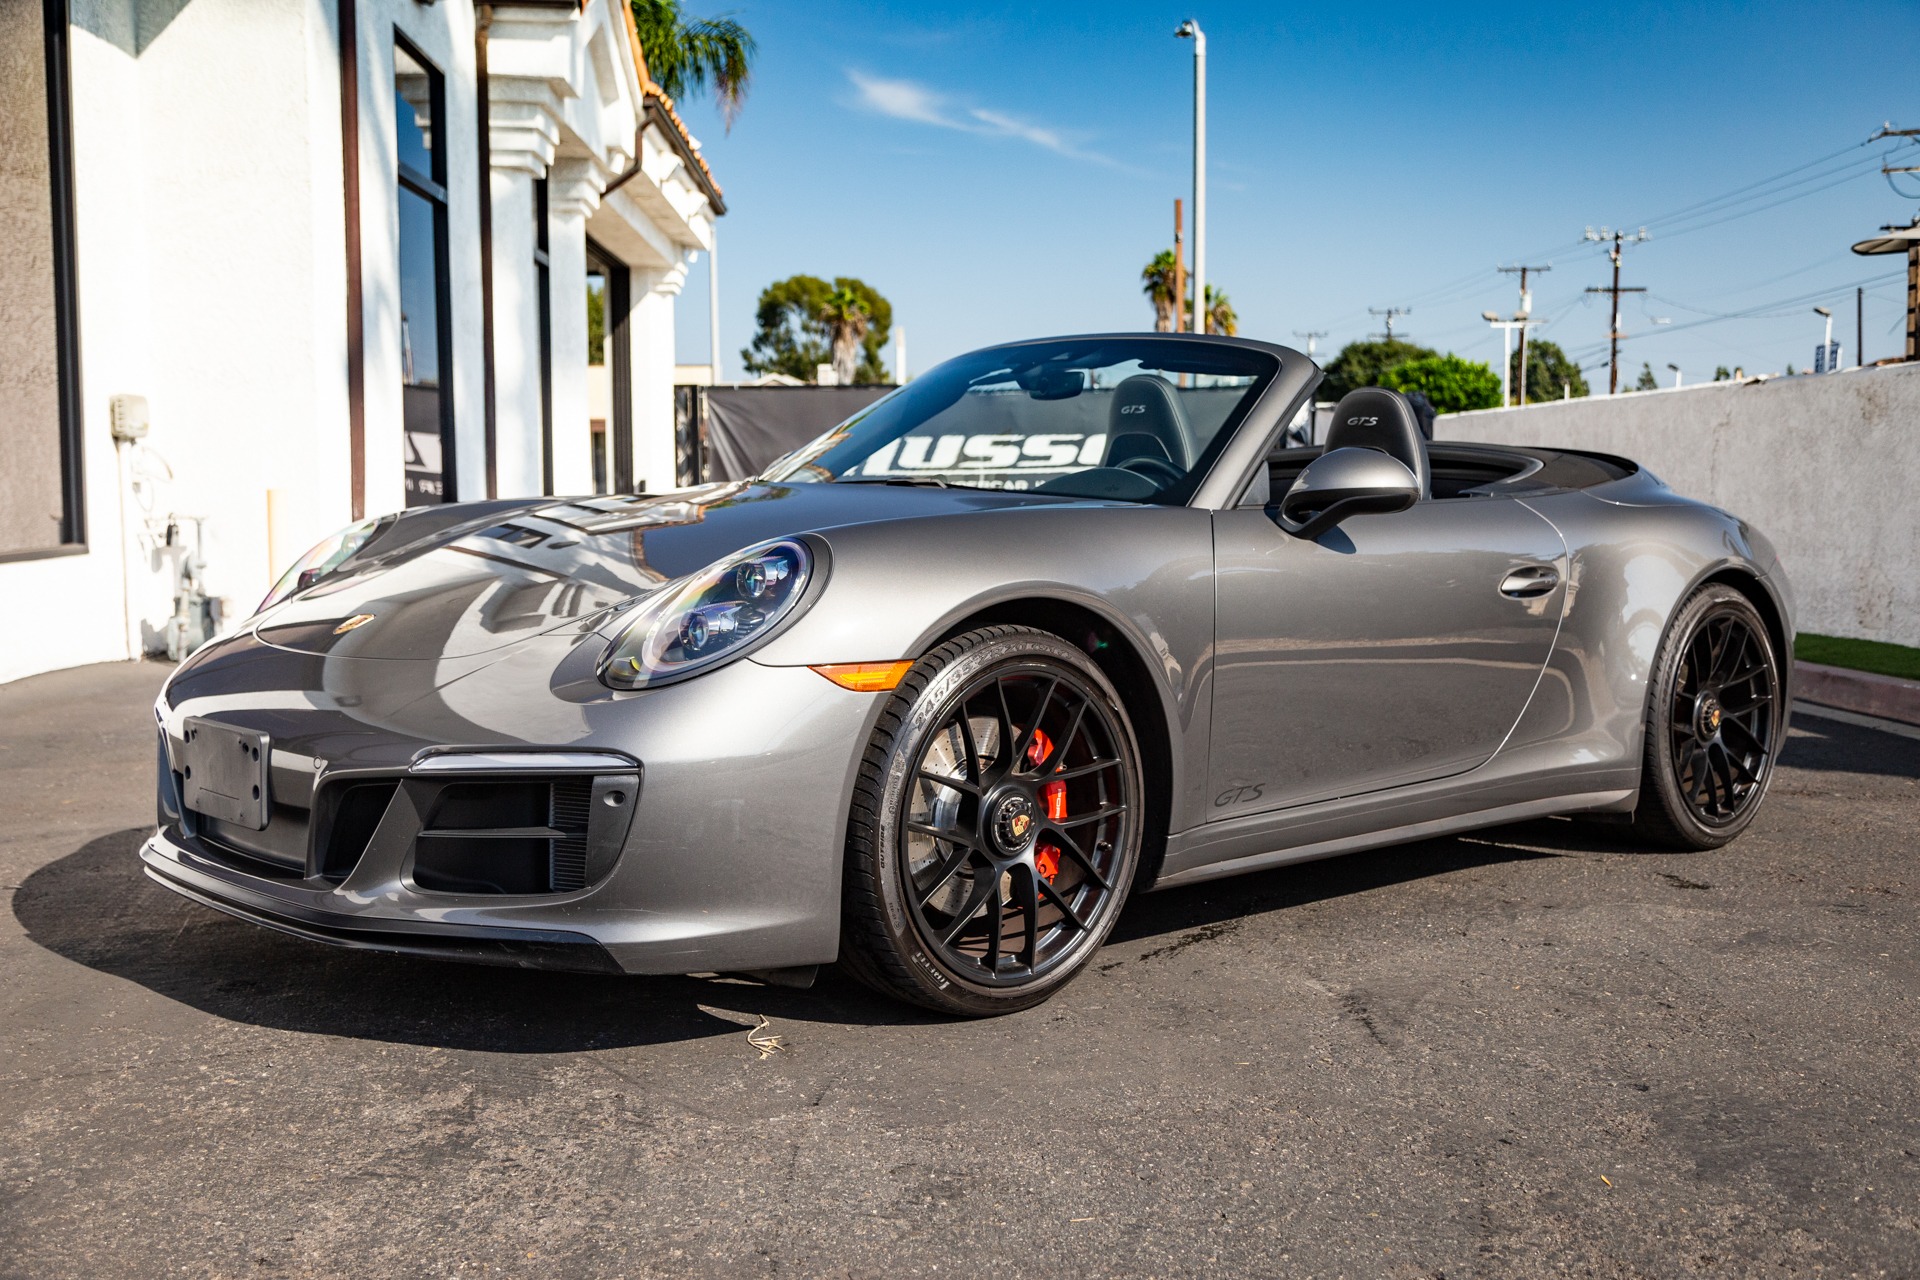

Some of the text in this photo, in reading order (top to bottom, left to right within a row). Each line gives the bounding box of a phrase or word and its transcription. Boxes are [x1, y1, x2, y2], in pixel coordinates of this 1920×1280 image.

[1121, 404, 1146, 414] GTS
[1347, 416, 1379, 427] GTS
[1214, 783, 1266, 807] GTS
[911, 952, 950, 991] PIRELLI
